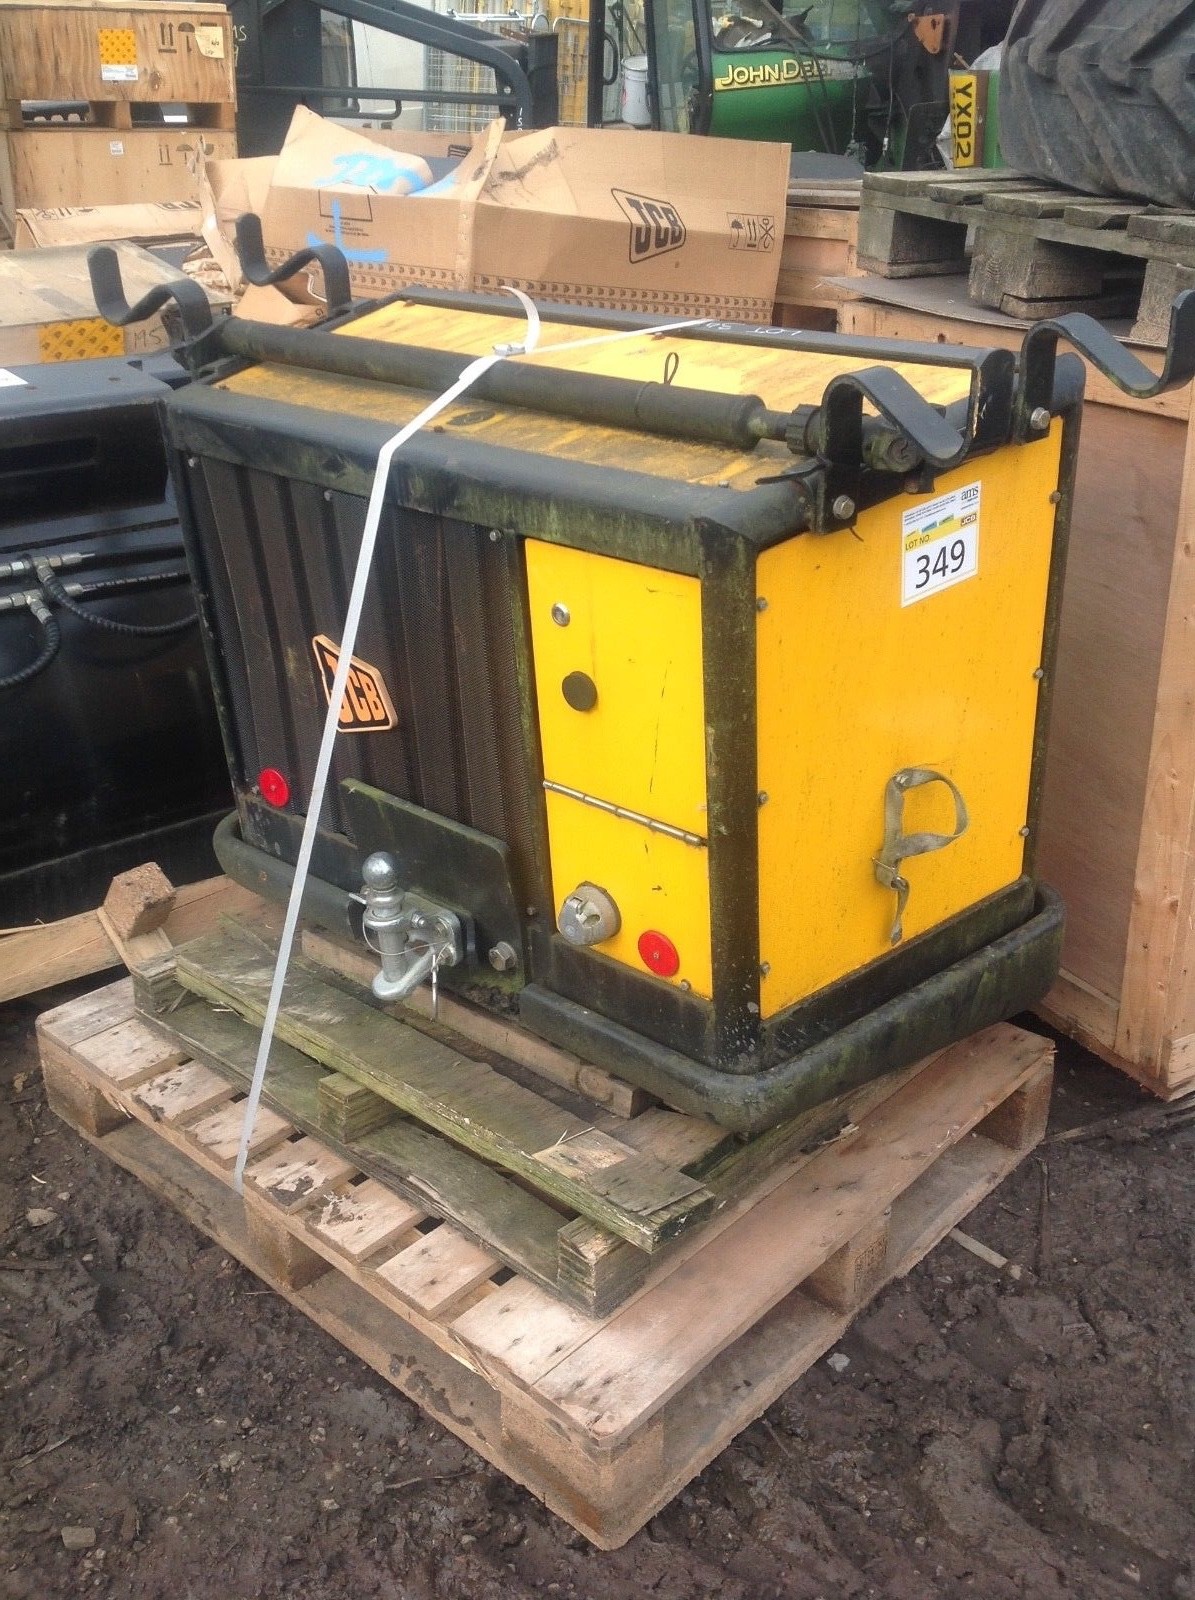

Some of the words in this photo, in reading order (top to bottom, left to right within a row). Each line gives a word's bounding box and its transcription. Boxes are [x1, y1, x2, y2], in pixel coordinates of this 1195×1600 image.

[721, 63, 780, 86] JOHN
[955, 81, 973, 160] YX02
[625, 196, 683, 255] JCB
[905, 538, 919, 551] LOT
[915, 539, 966, 589] 349
